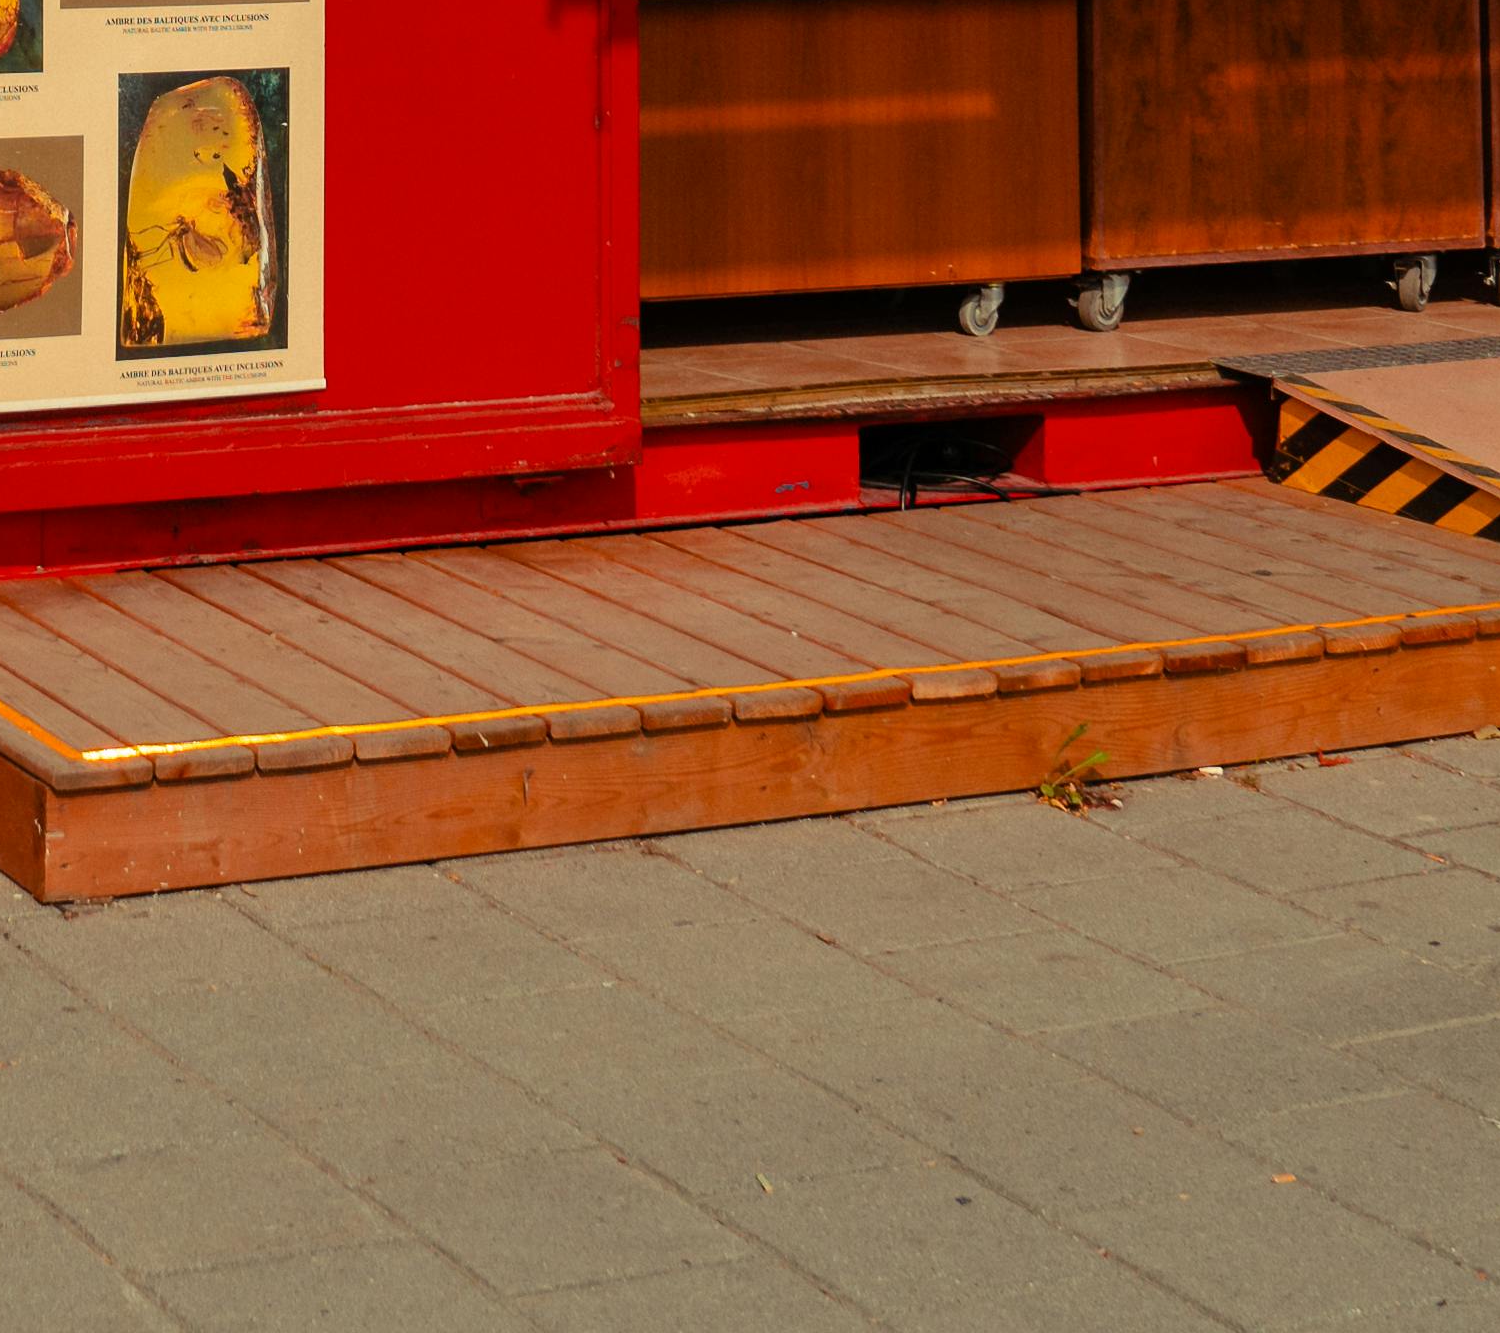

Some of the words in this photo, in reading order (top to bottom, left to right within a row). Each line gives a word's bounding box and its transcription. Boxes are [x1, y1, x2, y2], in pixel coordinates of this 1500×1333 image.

[105, 17, 135, 26] AMBRE
[136, 17, 152, 25] DES
[153, 15, 198, 24] BALTIQUES
[198, 15, 220, 23] AVEC
[222, 13, 269, 22] INCLUSIONS
[120, 370, 150, 380] AMBRE
[151, 368, 167, 377] DES
[168, 365, 212, 376] BALTIQUES
[213, 363, 235, 373] AVEC
[236, 360, 284, 371] INCLUSIONS
